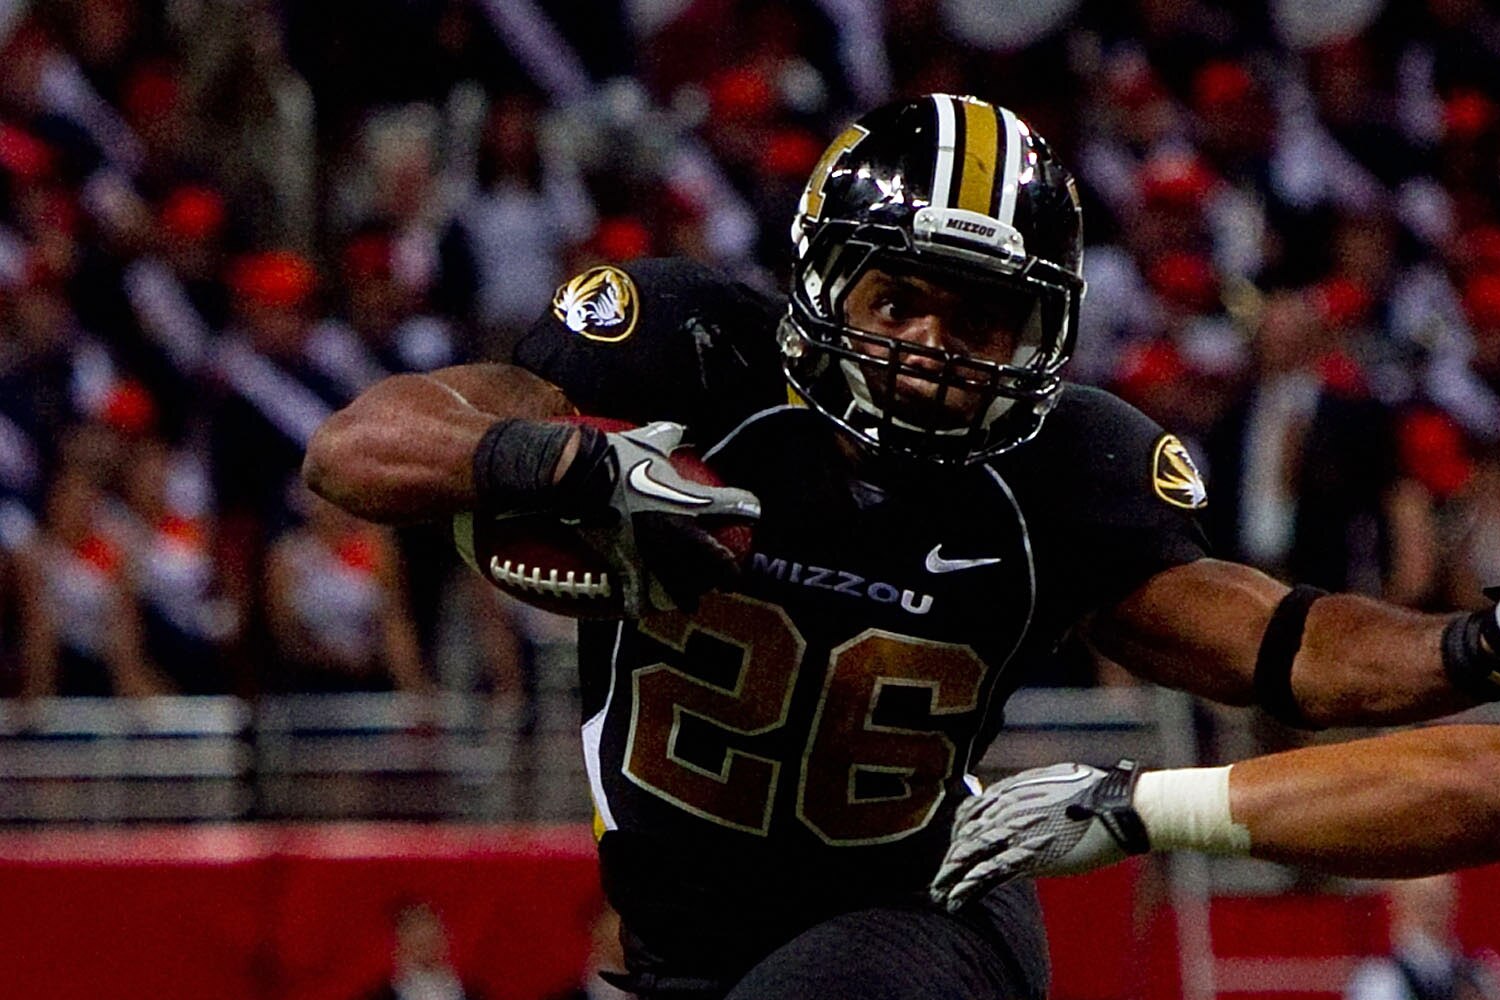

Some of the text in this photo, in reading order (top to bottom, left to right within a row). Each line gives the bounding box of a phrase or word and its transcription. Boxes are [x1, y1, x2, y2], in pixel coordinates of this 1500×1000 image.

[945, 218, 997, 238] MIZZOU
[752, 552, 934, 615] MIZZOU
[621, 588, 989, 847] 26
